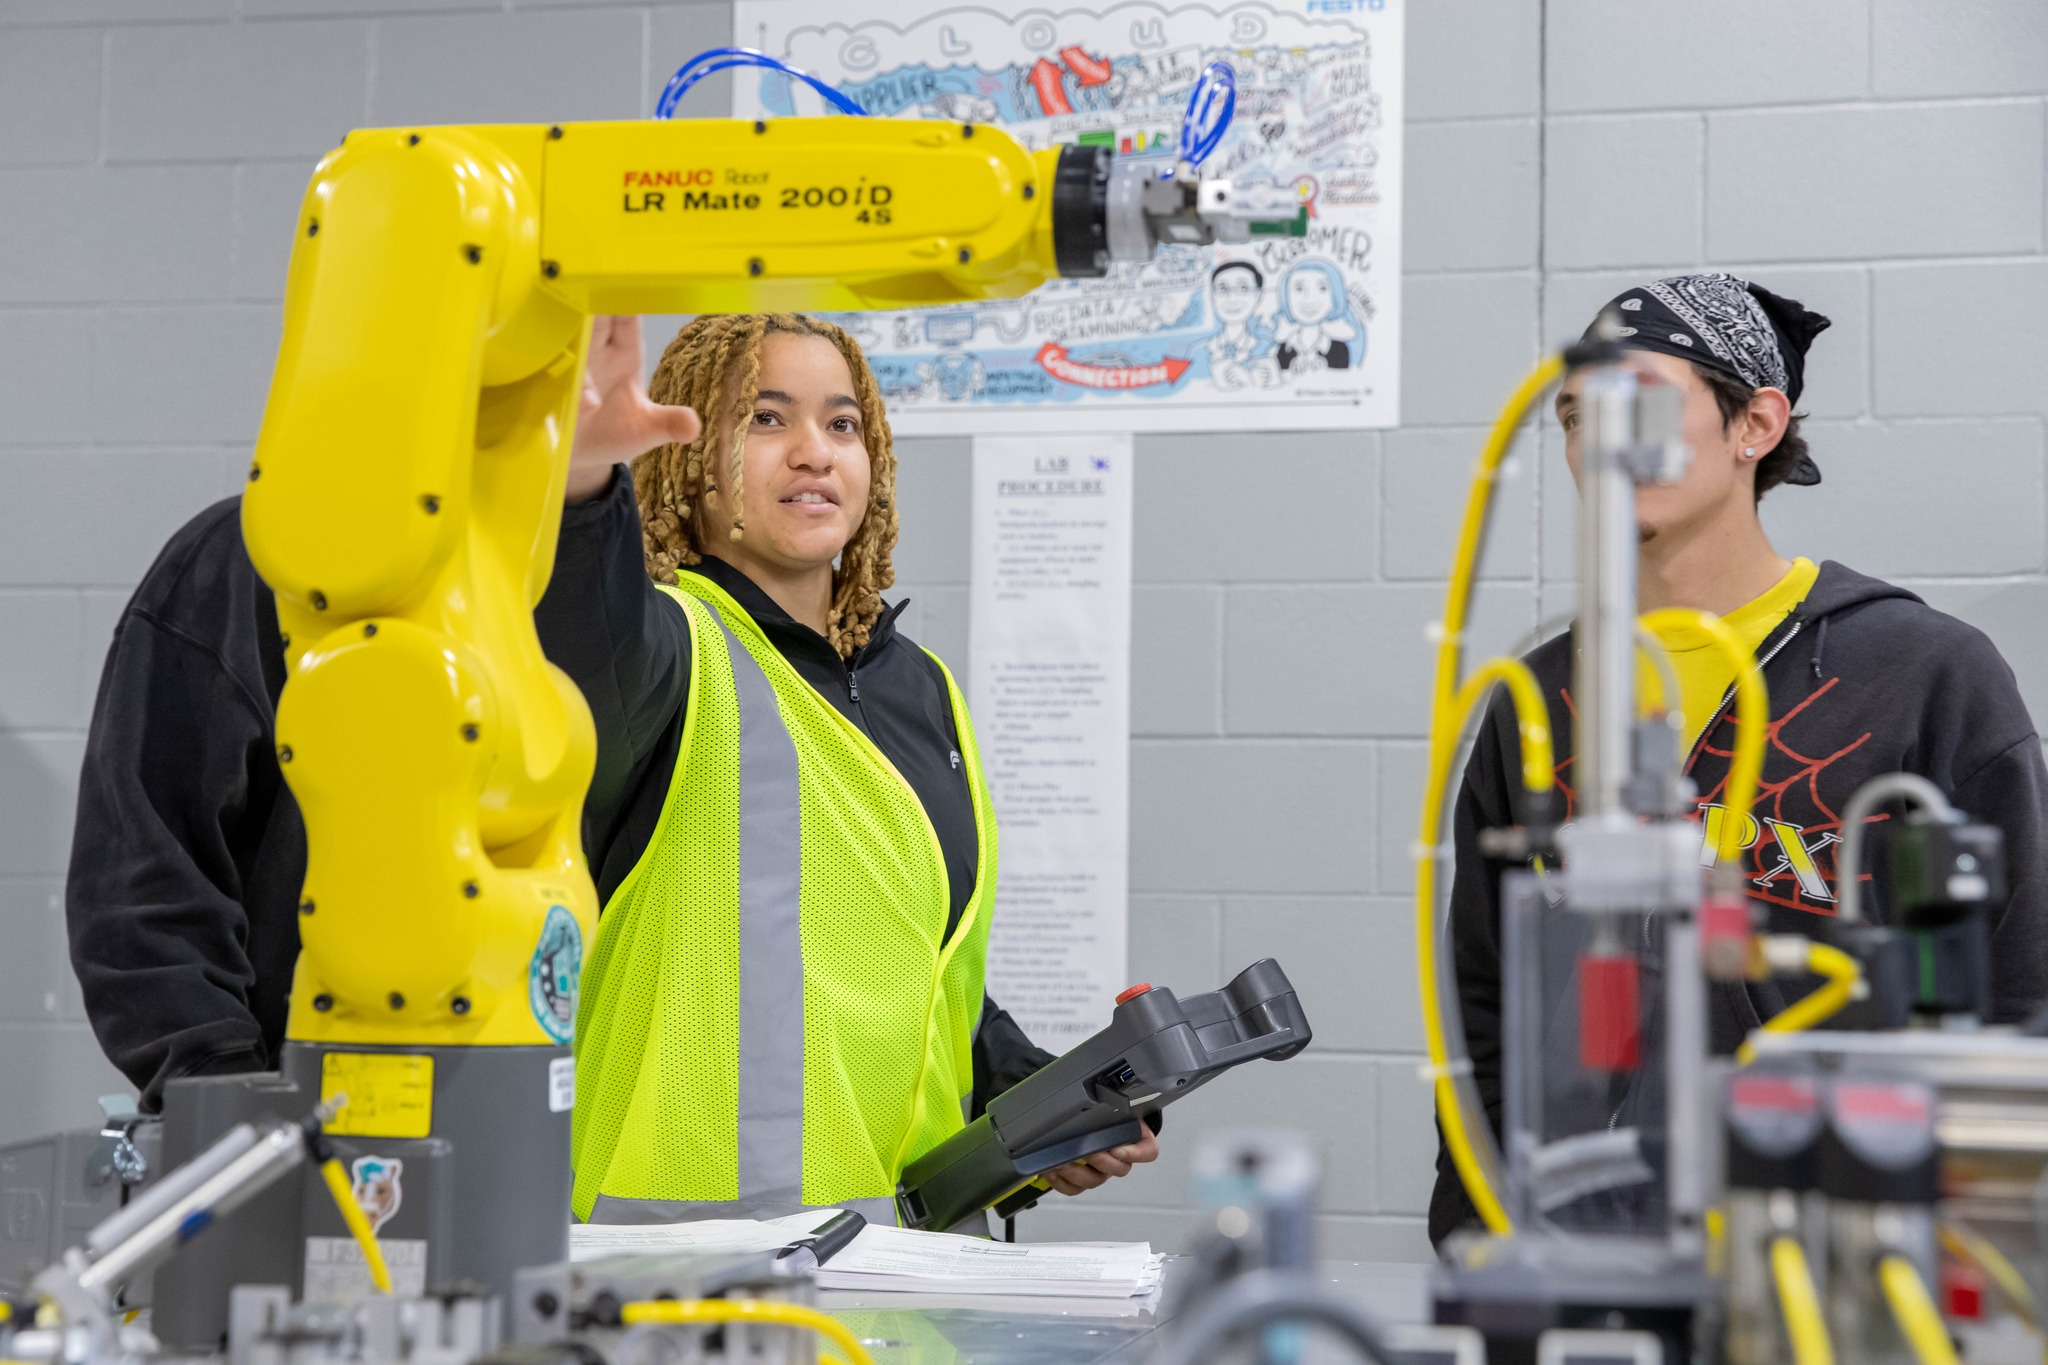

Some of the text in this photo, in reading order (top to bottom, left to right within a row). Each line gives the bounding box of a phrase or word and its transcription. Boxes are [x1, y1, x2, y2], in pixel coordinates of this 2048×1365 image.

[1307, 0, 1385, 13] FESTO
[623, 168, 770, 188] FANUC Robot
[623, 175, 893, 213] LR Mate 200iD
[855, 209, 893, 226] 4S
